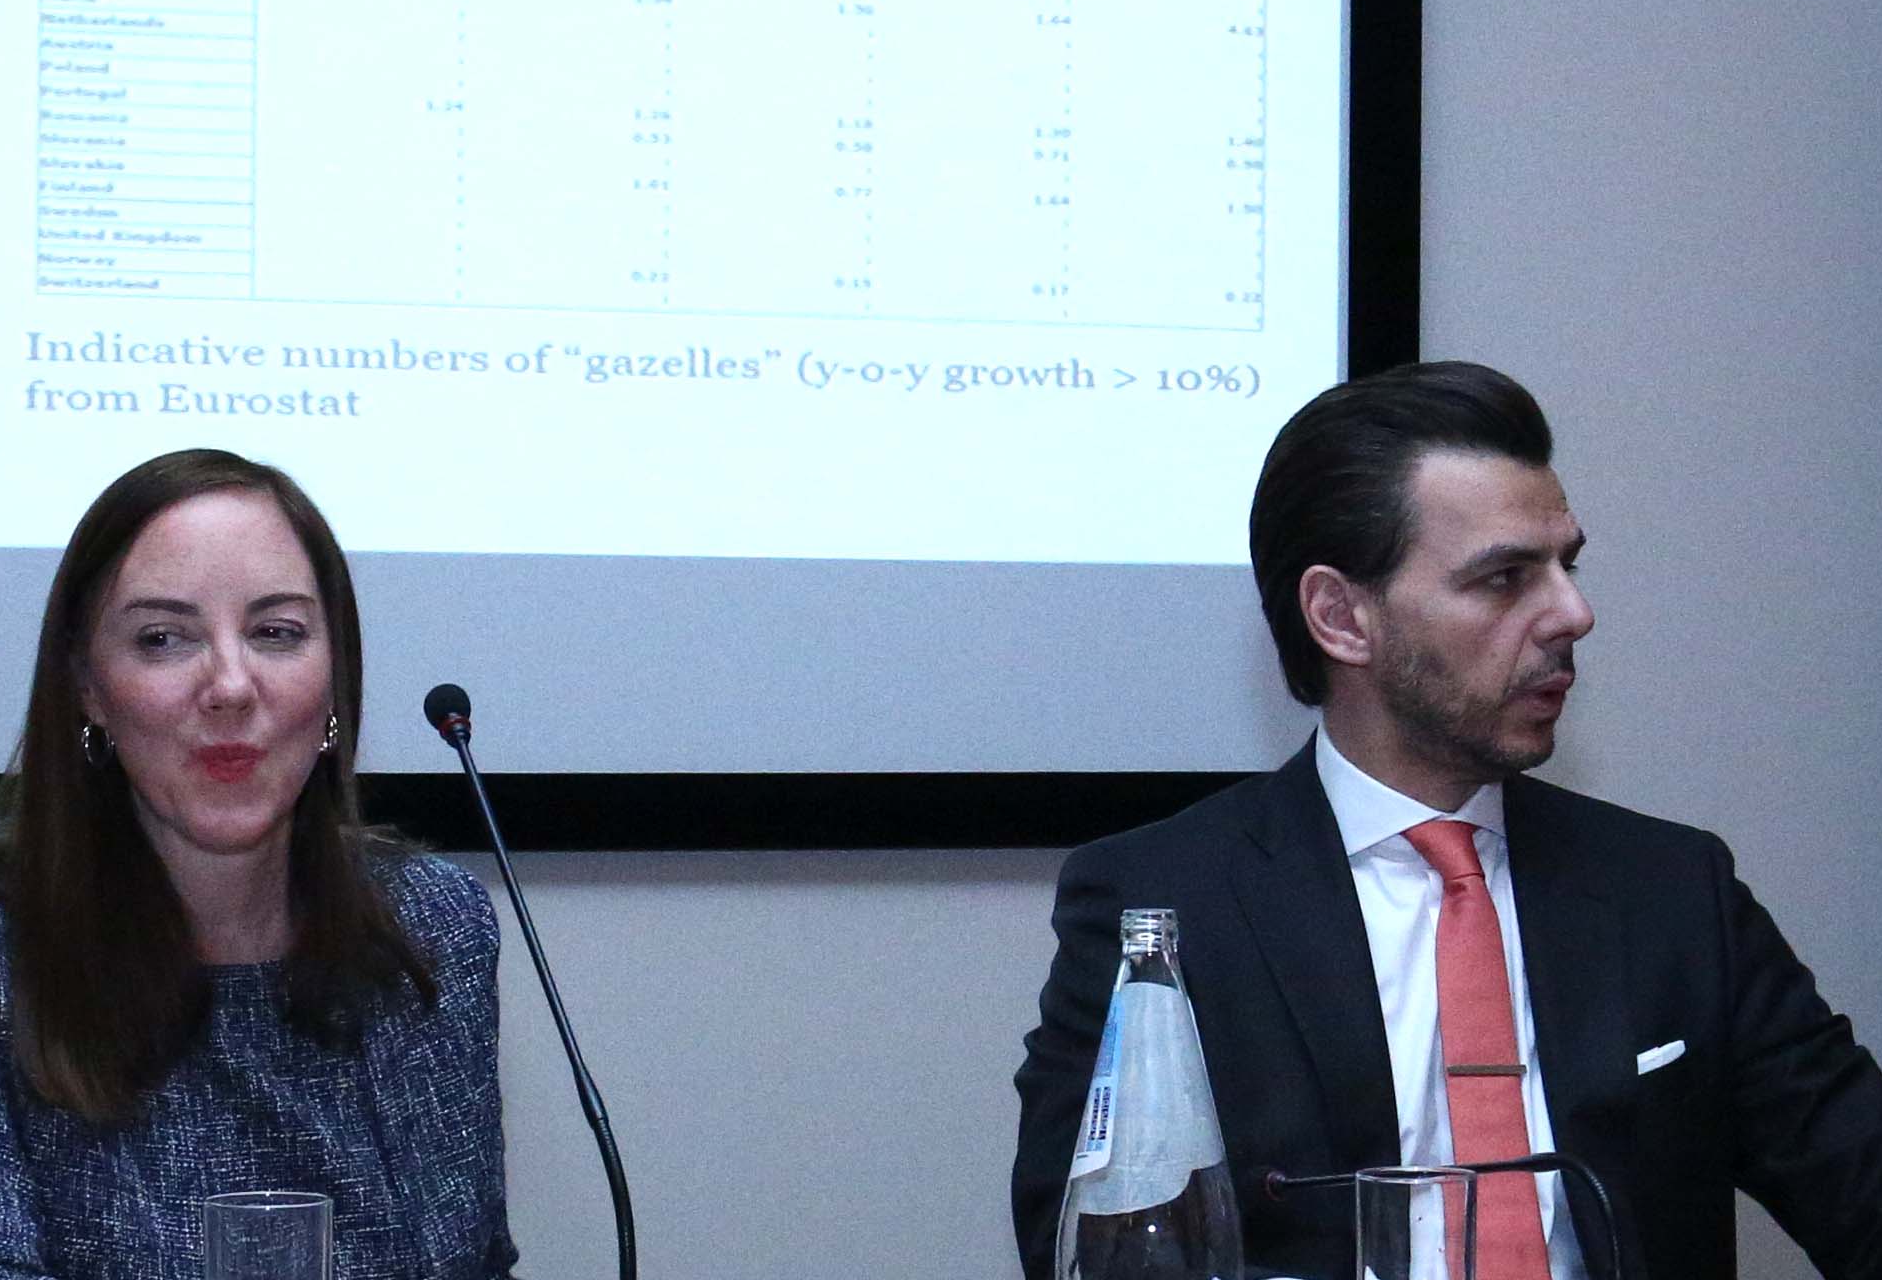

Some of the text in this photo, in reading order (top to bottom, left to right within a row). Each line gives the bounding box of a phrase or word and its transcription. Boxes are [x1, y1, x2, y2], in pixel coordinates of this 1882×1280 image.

[26, 330, 266, 367] Indicative
[281, 337, 490, 373] numbers
[503, 341, 554, 375] of
[796, 349, 930, 393] (y-o-y
[941, 356, 1096, 394] growth
[1156, 363, 1261, 399] 10%)
[24, 377, 361, 417] from Eurostat
